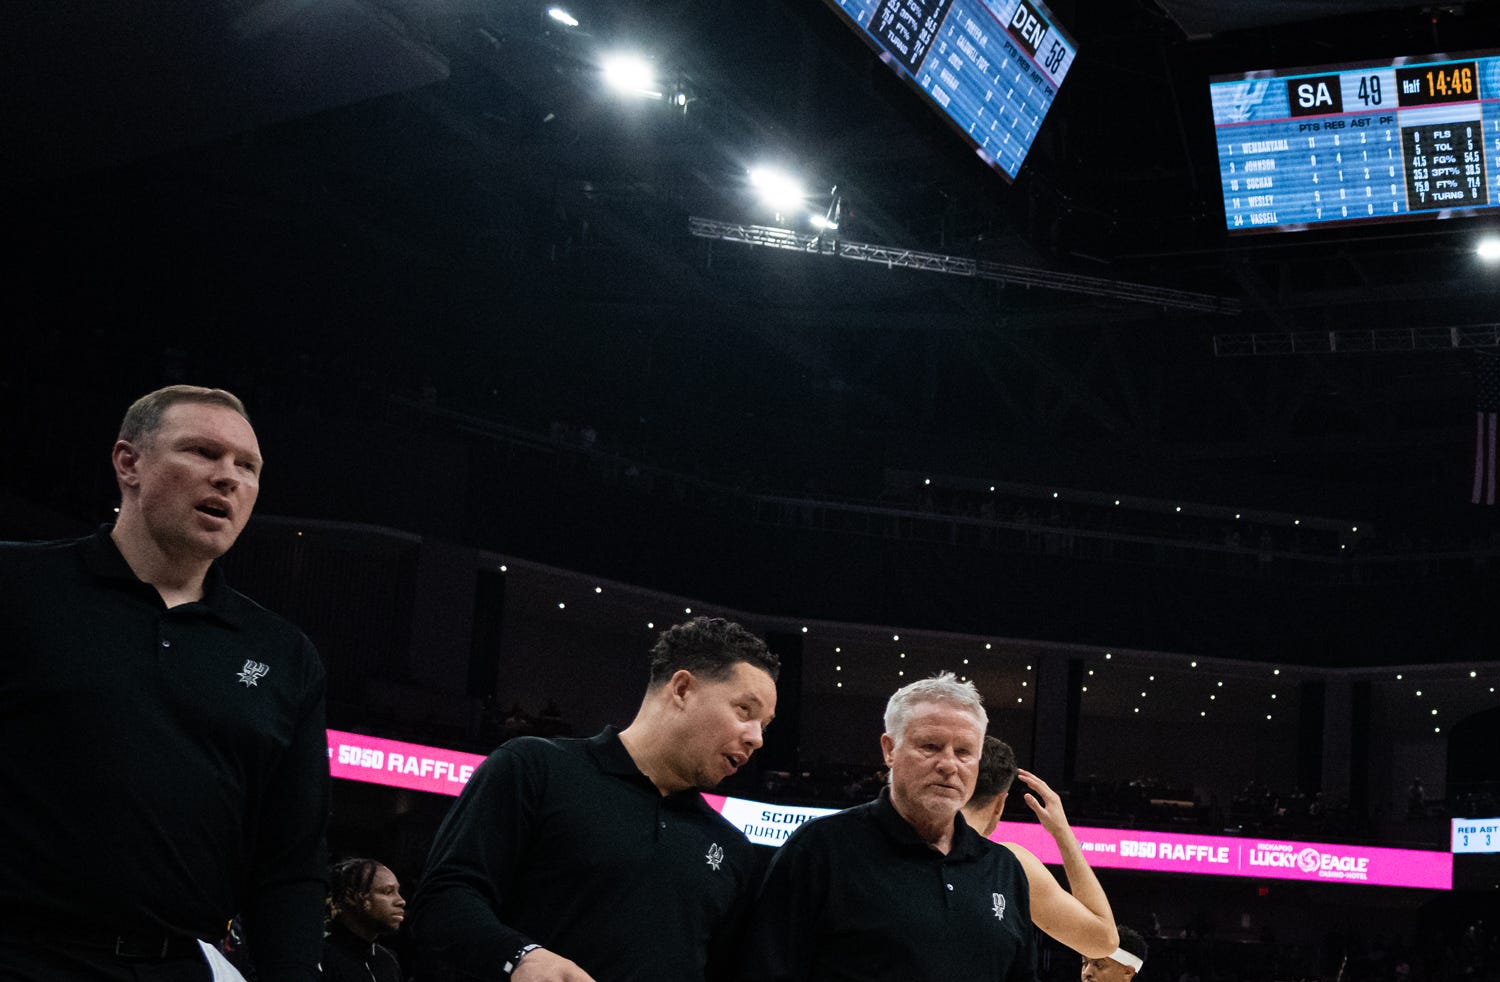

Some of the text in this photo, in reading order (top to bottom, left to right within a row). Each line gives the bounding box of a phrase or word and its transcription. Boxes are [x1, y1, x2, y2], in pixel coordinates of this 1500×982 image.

[1011, 3, 1066, 75] DEN 58
[1403, 67, 1472, 97] Half 14:46
[1297, 75, 1382, 108] SA 49
[1299, 116, 1393, 132] PTS REB AST PF
[1433, 130, 1451, 139] FLS
[1434, 143, 1453, 151] TOL
[1413, 151, 1480, 167] 41.5 FG% 54.5
[1431, 167, 1460, 177] 3PT%
[1436, 180, 1458, 188] FT%
[1467, 177, 1480, 188] 71.4
[1248, 195, 1274, 208] WESLEY
[1432, 191, 1464, 200] TURNS
[1234, 215, 1243, 226] 24
[1250, 212, 1278, 225] VASSELL
[387, 752, 474, 784] RAFFLE
[1457, 826, 1476, 834] REB
[1159, 843, 1230, 864] RAFFLE
[1249, 849, 1369, 872] LUCKY EAGLE
